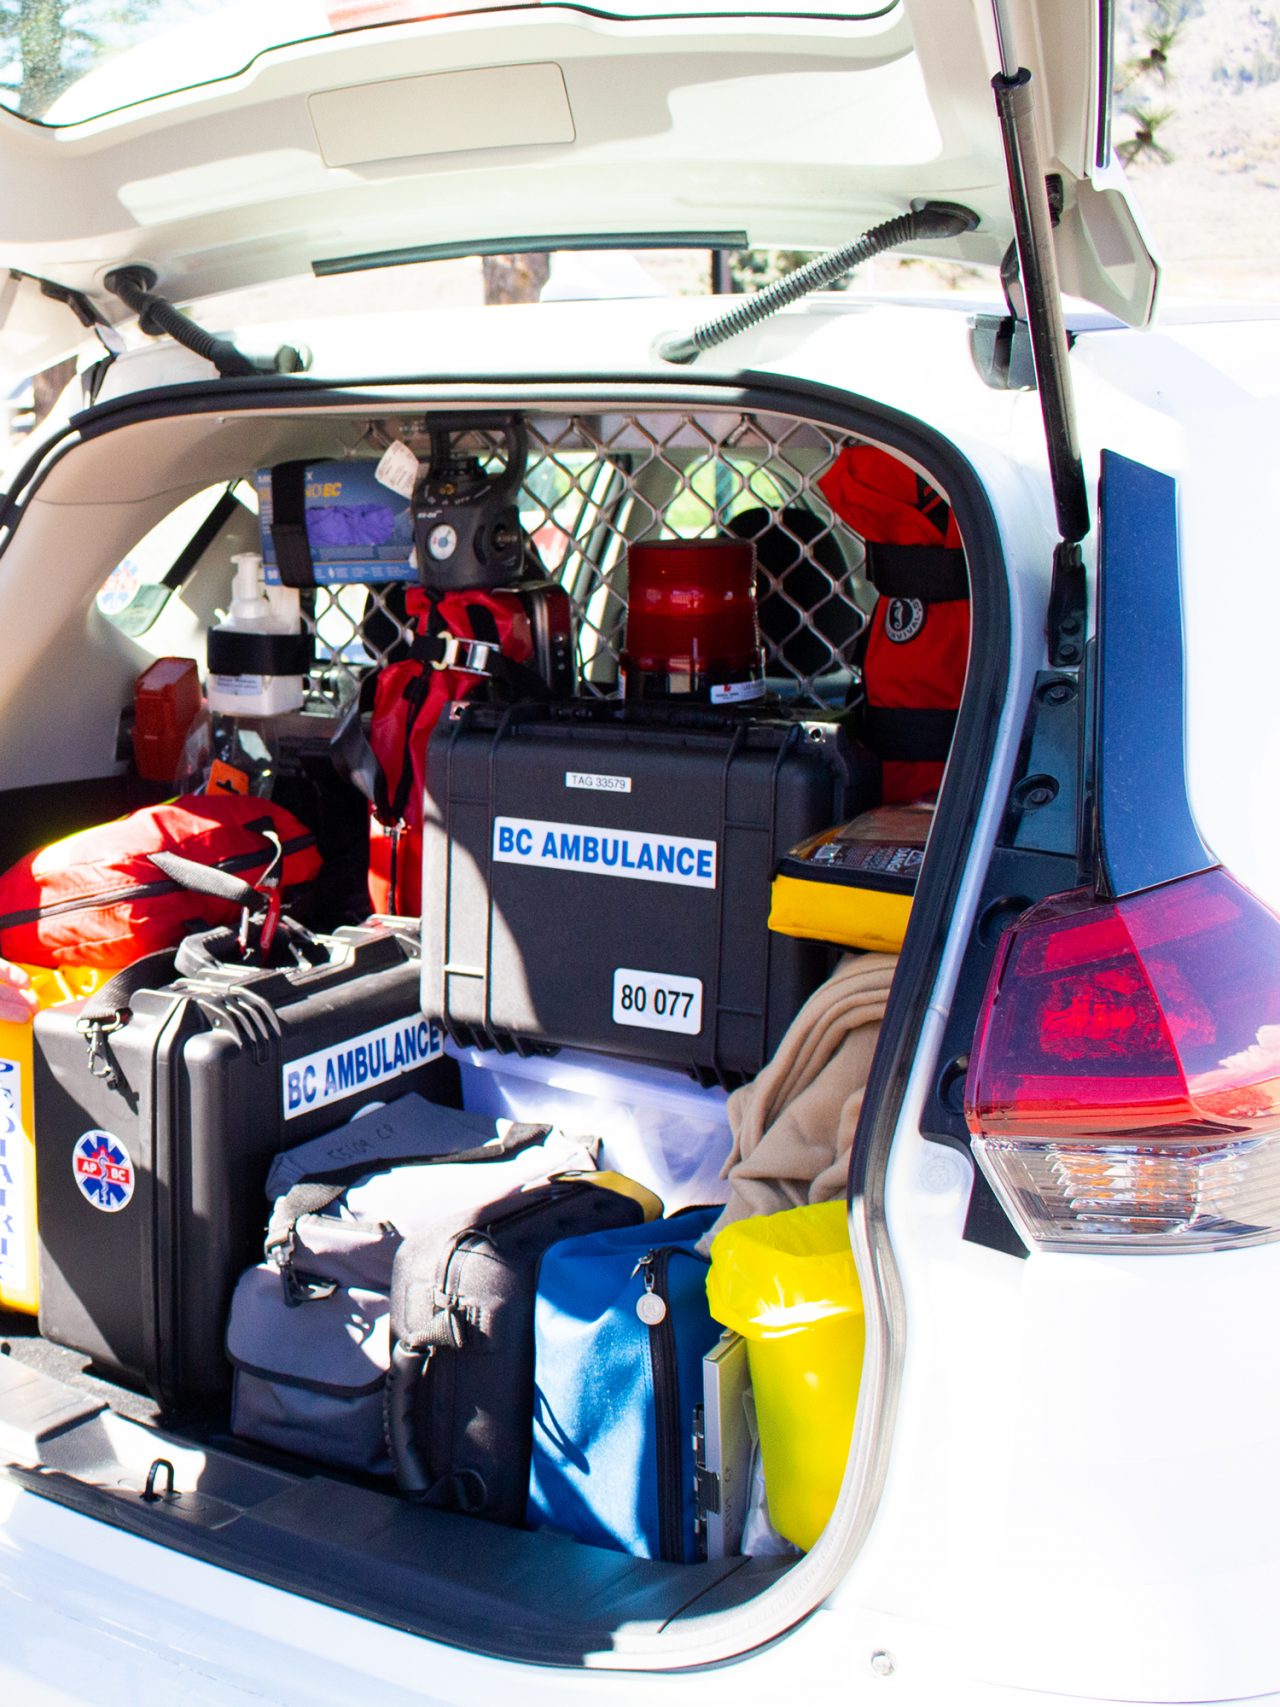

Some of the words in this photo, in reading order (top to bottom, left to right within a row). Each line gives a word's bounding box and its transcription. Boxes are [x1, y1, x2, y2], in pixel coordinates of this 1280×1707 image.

[571, 775, 594, 788] TAG
[595, 776, 627, 791] 33579
[498, 826, 534, 855] BC
[541, 831, 714, 878] AMBULANCE
[621, 984, 647, 1012] 80
[654, 989, 695, 1018] 077
[287, 1065, 318, 1110] BC
[323, 1021, 441, 1095] AMBULANCE
[82, 1161, 98, 1173] AP
[110, 1168, 127, 1181] BC
